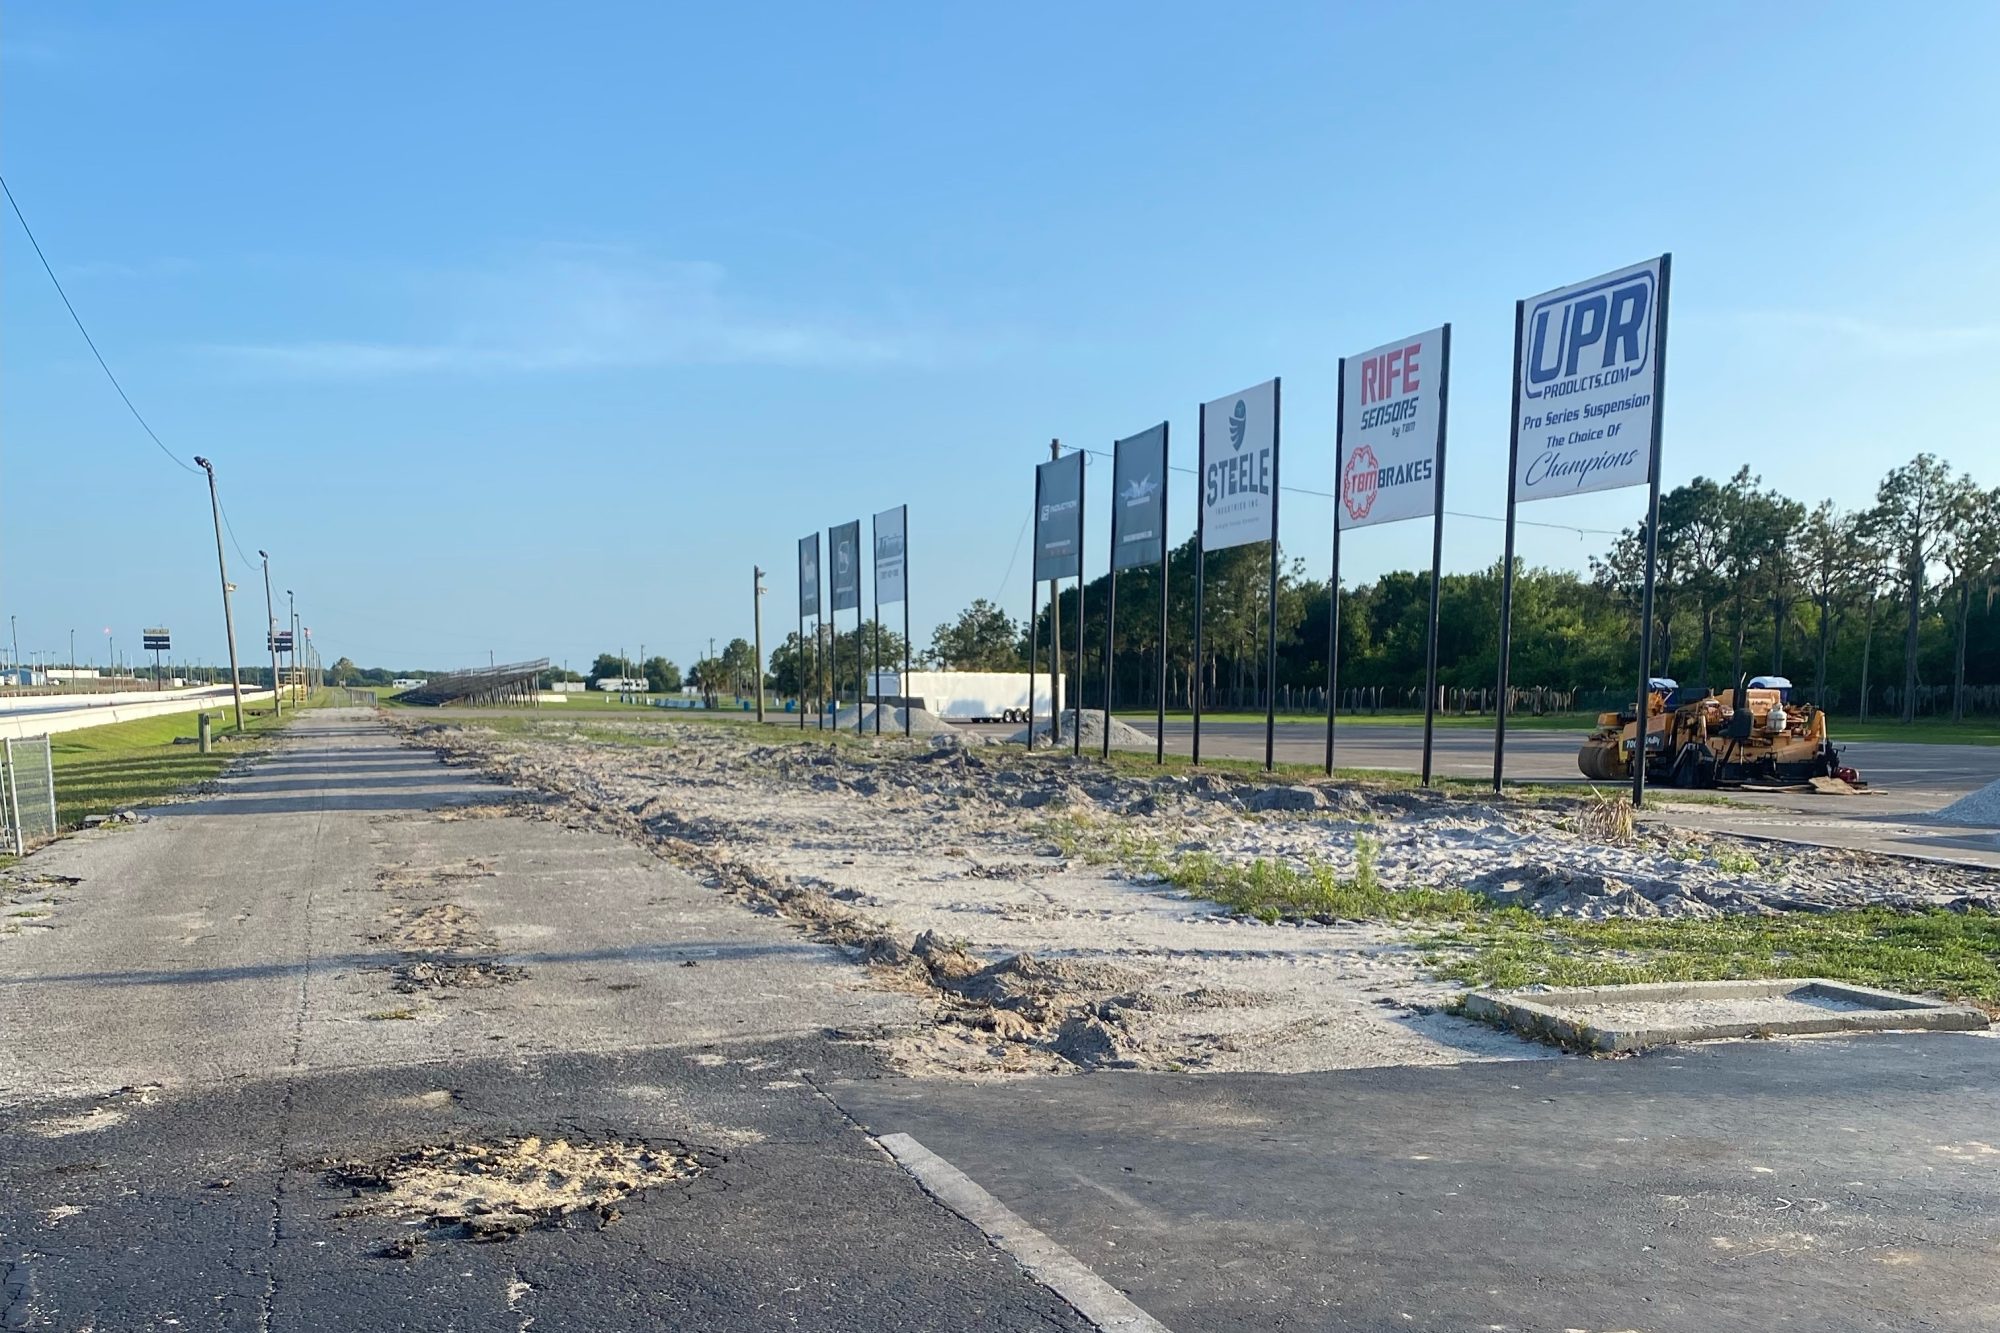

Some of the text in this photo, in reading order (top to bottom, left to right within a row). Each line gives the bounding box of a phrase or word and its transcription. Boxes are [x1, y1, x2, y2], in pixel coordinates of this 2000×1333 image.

[1530, 282, 1648, 384] UPR
[1361, 343, 1422, 406] RIFE
[1543, 366, 1630, 399] PRODUCTS.COM
[1361, 396, 1419, 430] SENSORS
[1523, 393, 1650, 430] Pro Series Suspension
[1391, 425, 1401, 438] by
[1546, 423, 1622, 448] The Choice Of
[1206, 448, 1269, 507] STEELE
[1525, 449, 1639, 487] Champions
